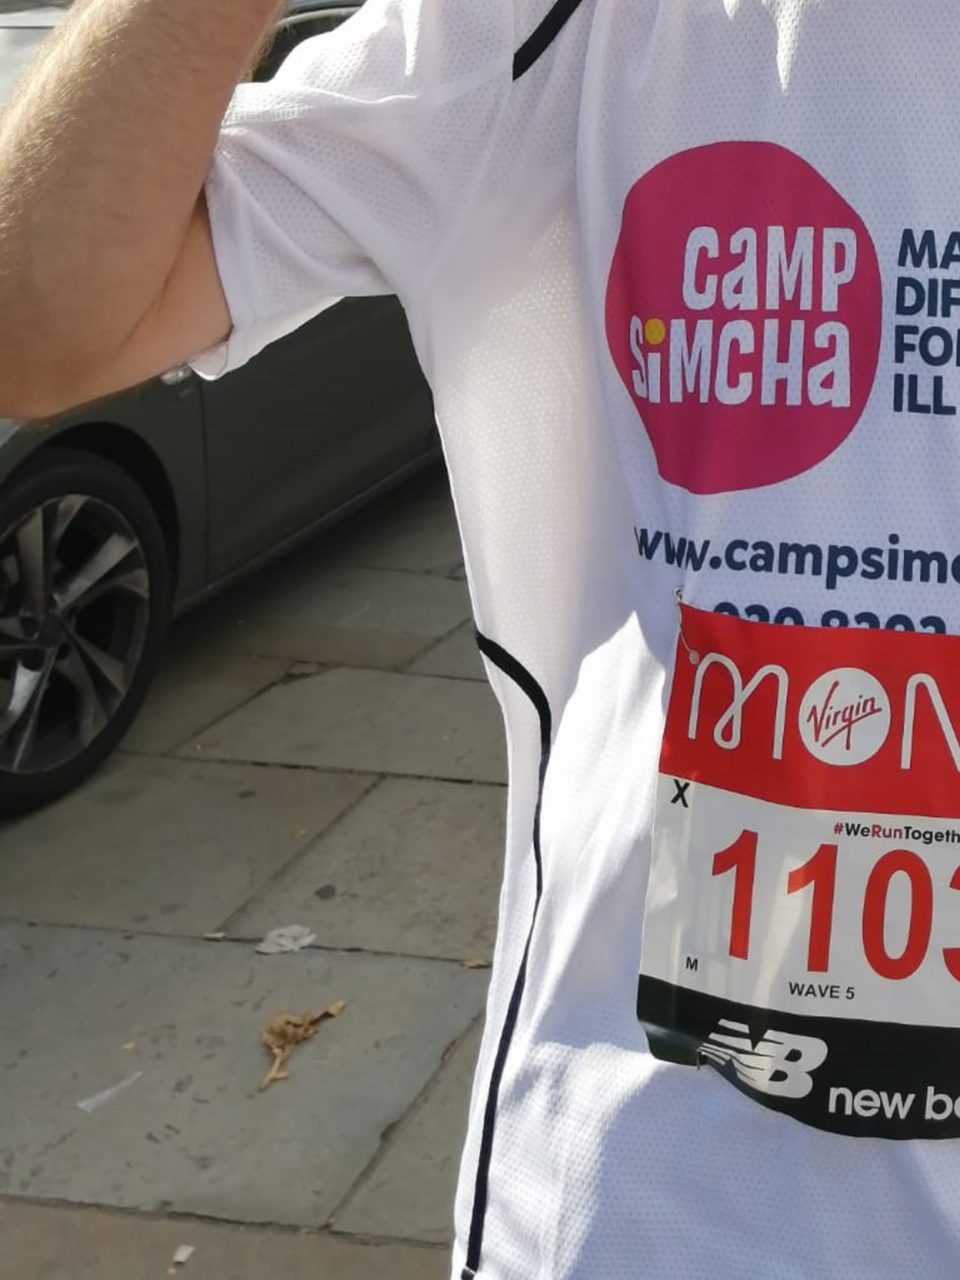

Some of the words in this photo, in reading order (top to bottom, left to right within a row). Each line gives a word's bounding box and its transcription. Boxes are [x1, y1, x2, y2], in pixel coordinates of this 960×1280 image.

[892, 373, 957, 416] ILL
[806, 680, 884, 751] Virgin
[685, 956, 699, 972] M
[789, 981, 841, 999] WAVE
[845, 986, 856, 1000] 5
[828, 1086, 916, 1119] new
